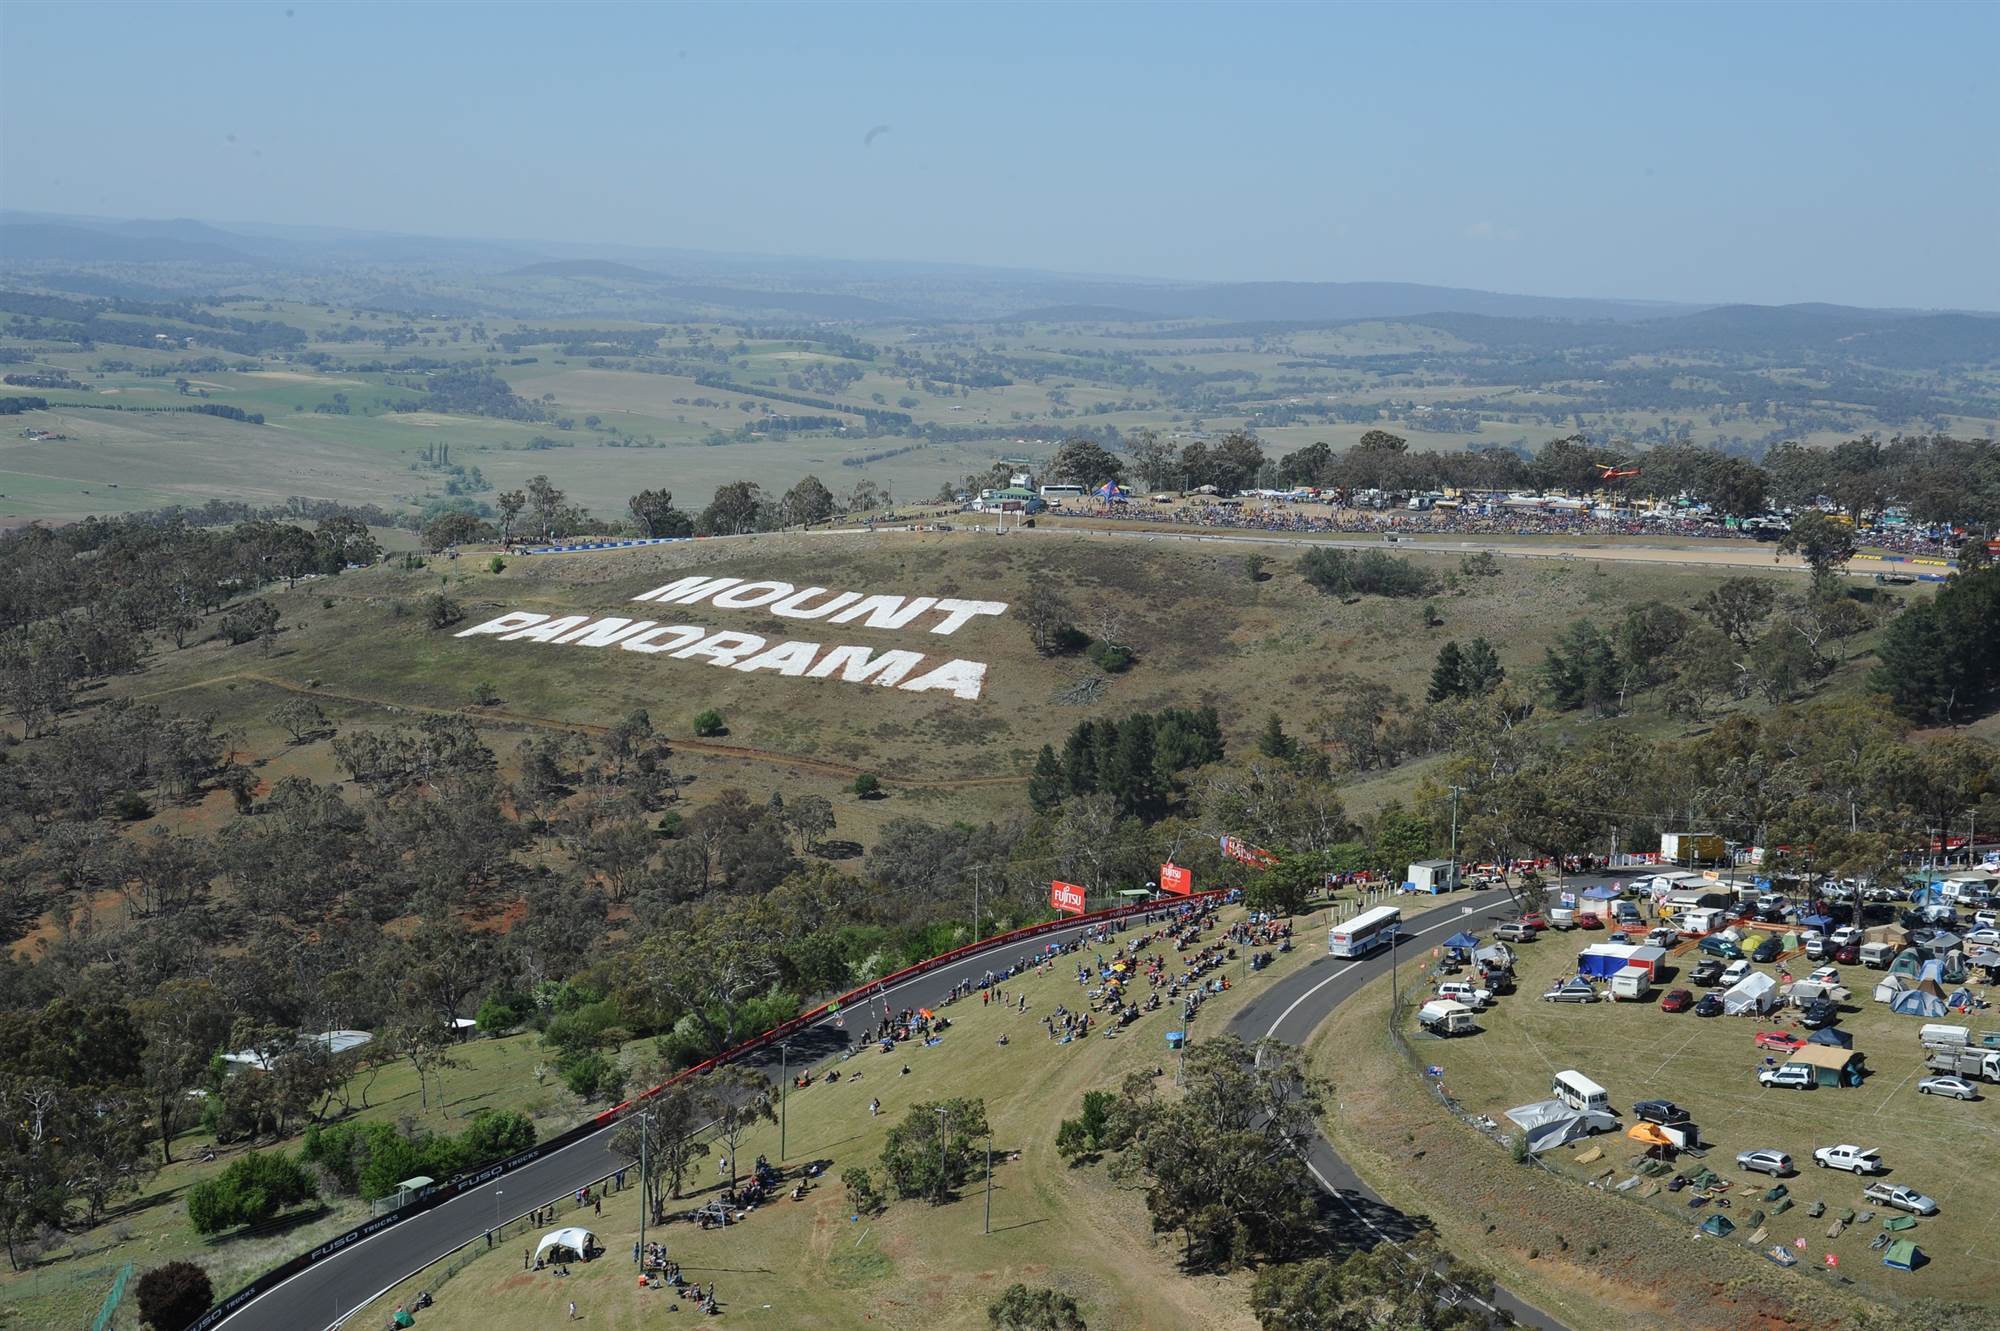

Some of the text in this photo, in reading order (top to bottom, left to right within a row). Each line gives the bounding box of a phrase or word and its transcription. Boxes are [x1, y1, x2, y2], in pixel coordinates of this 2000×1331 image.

[632, 576, 1008, 635] MOUNT
[454, 611, 988, 701] PANORAMA
[1055, 887, 1081, 906] FUJITSU
[457, 1150, 539, 1190] FUSO TRUCKS
[311, 1214, 399, 1260] FUSO TRUCKS
[226, 1287, 256, 1310] TRUCKS
